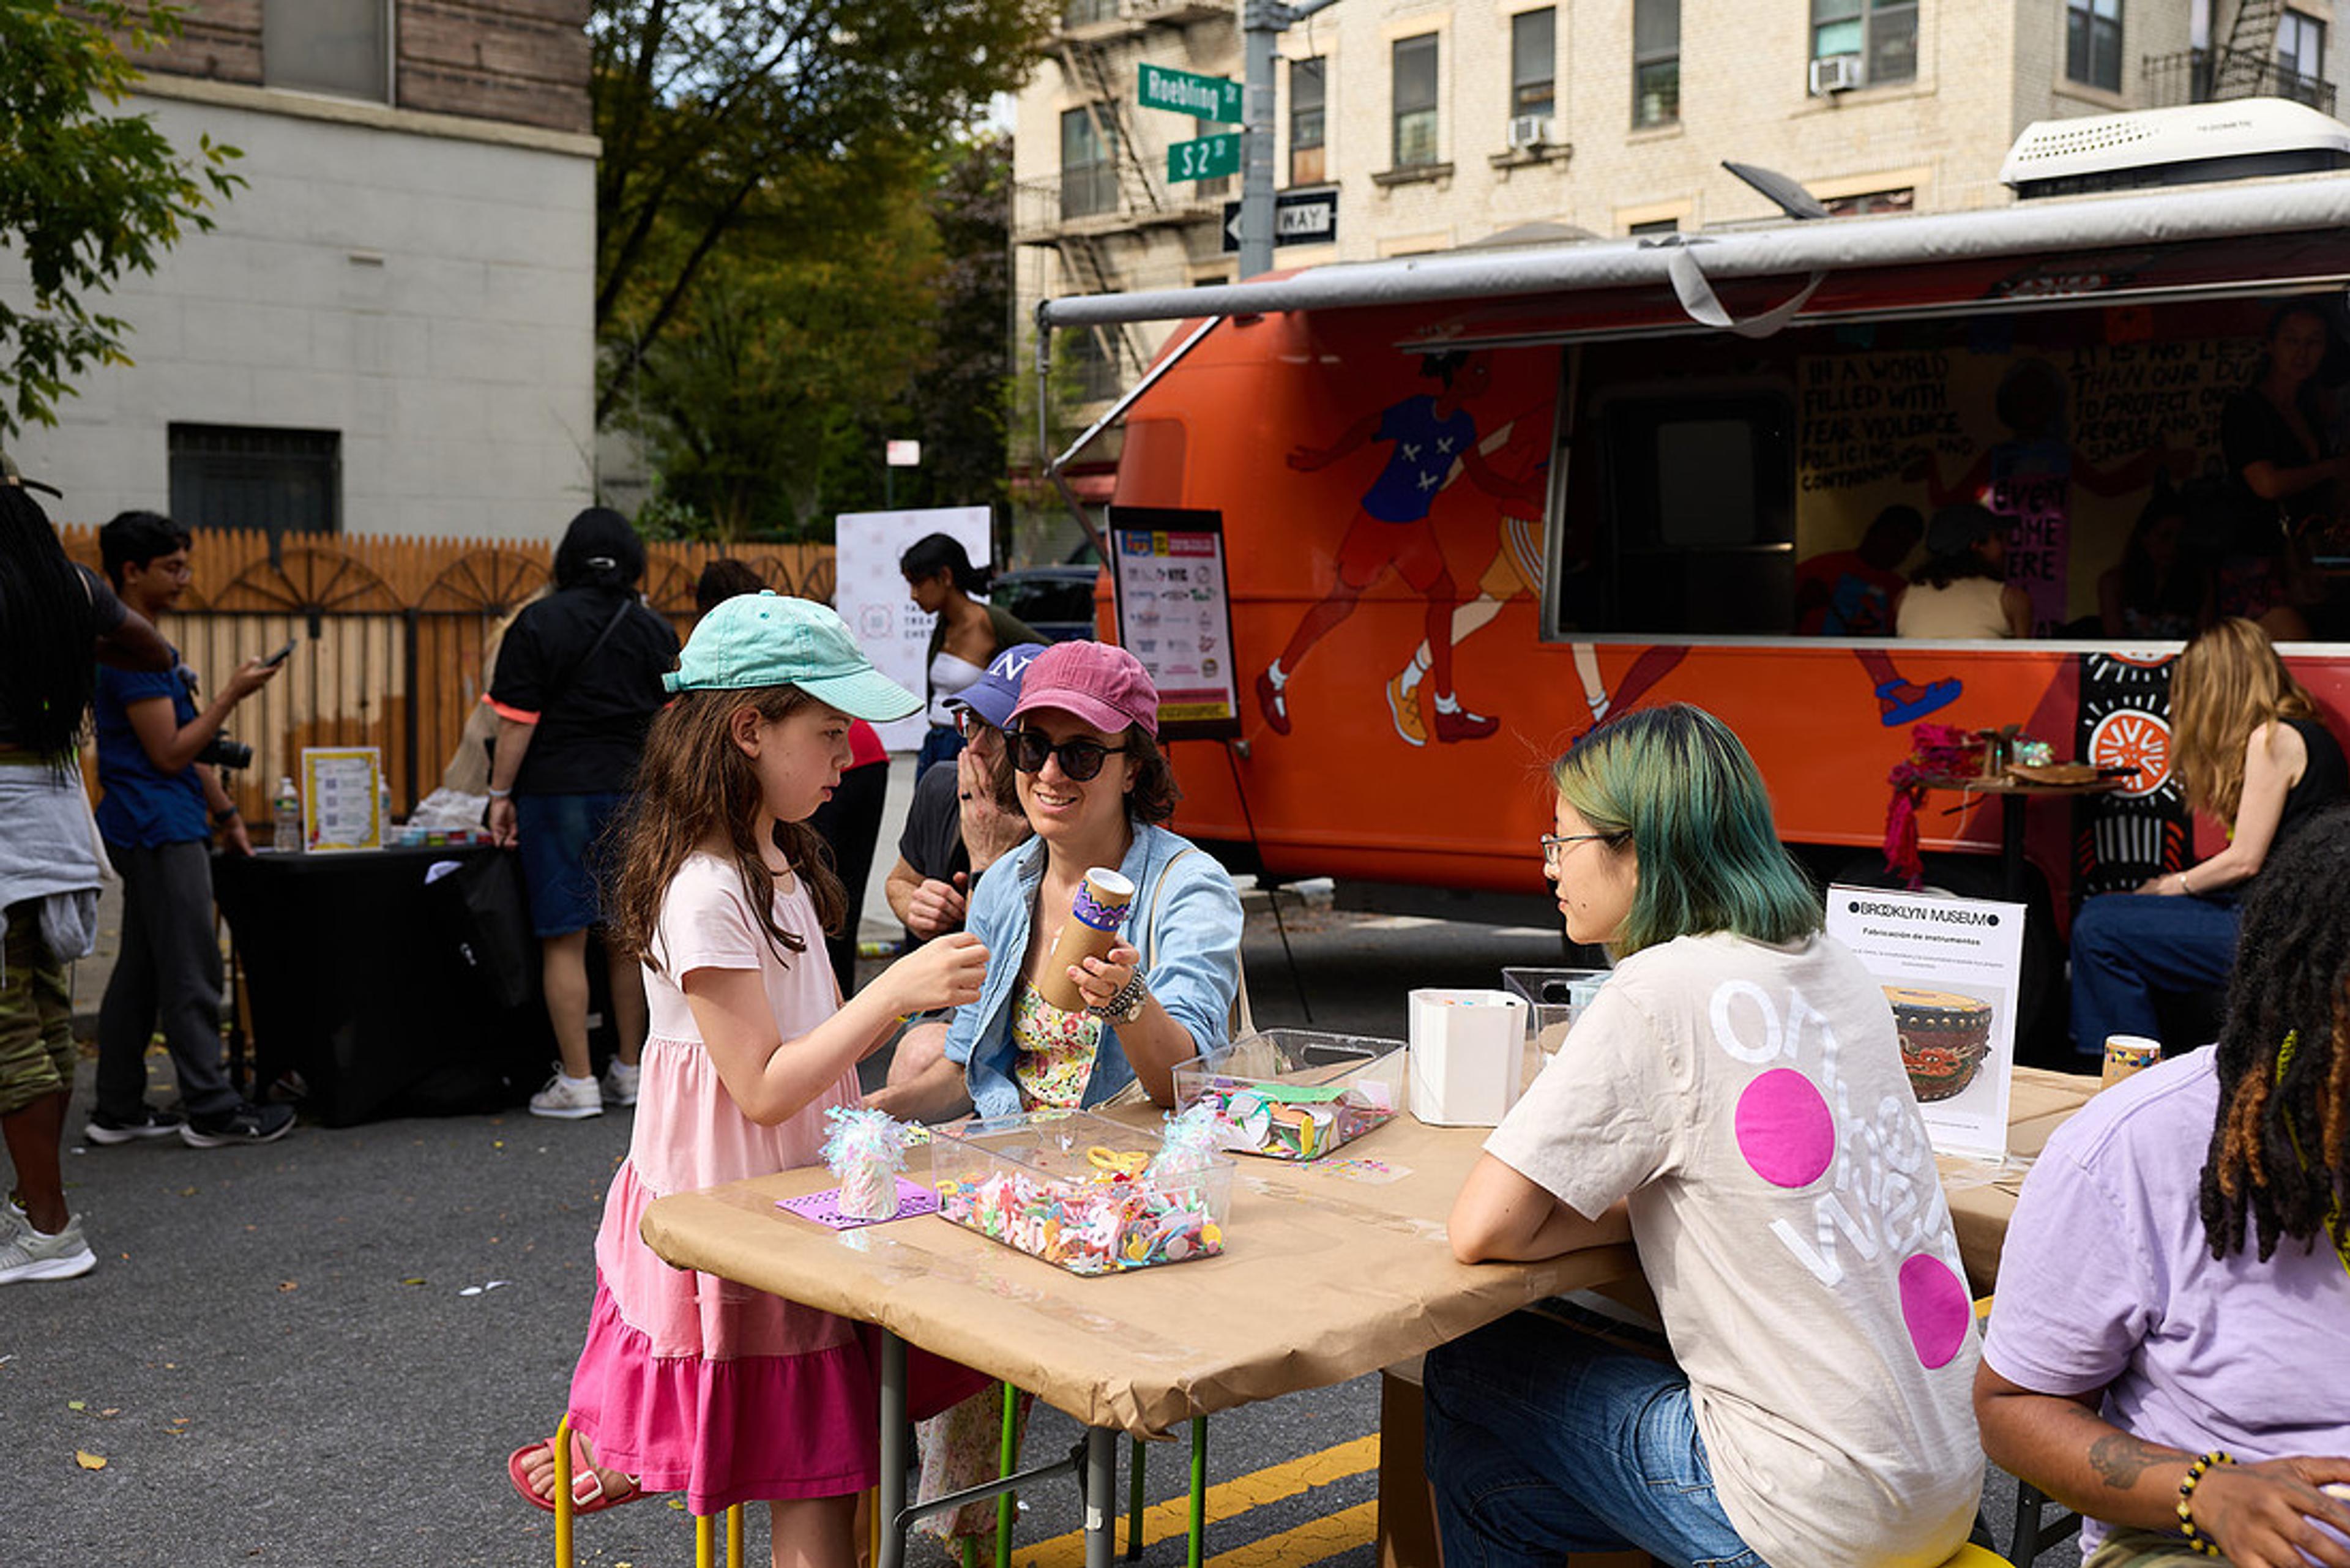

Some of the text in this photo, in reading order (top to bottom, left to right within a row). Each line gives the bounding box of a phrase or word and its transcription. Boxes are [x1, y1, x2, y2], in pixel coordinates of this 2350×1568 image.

[1148, 69, 1219, 120] Roebling
[1182, 145, 1193, 176] S
[1281, 208, 1321, 230] WAY
[2149, 343, 2186, 360] NO
[1809, 354, 1949, 386] IN A WORLD
[1804, 382, 1947, 417] FILLED WITH
[1803, 417, 1854, 444] FEAR
[1860, 902, 1986, 926] BROOKLYN MUSEUM
[1925, 934, 1981, 946] instrumentos
